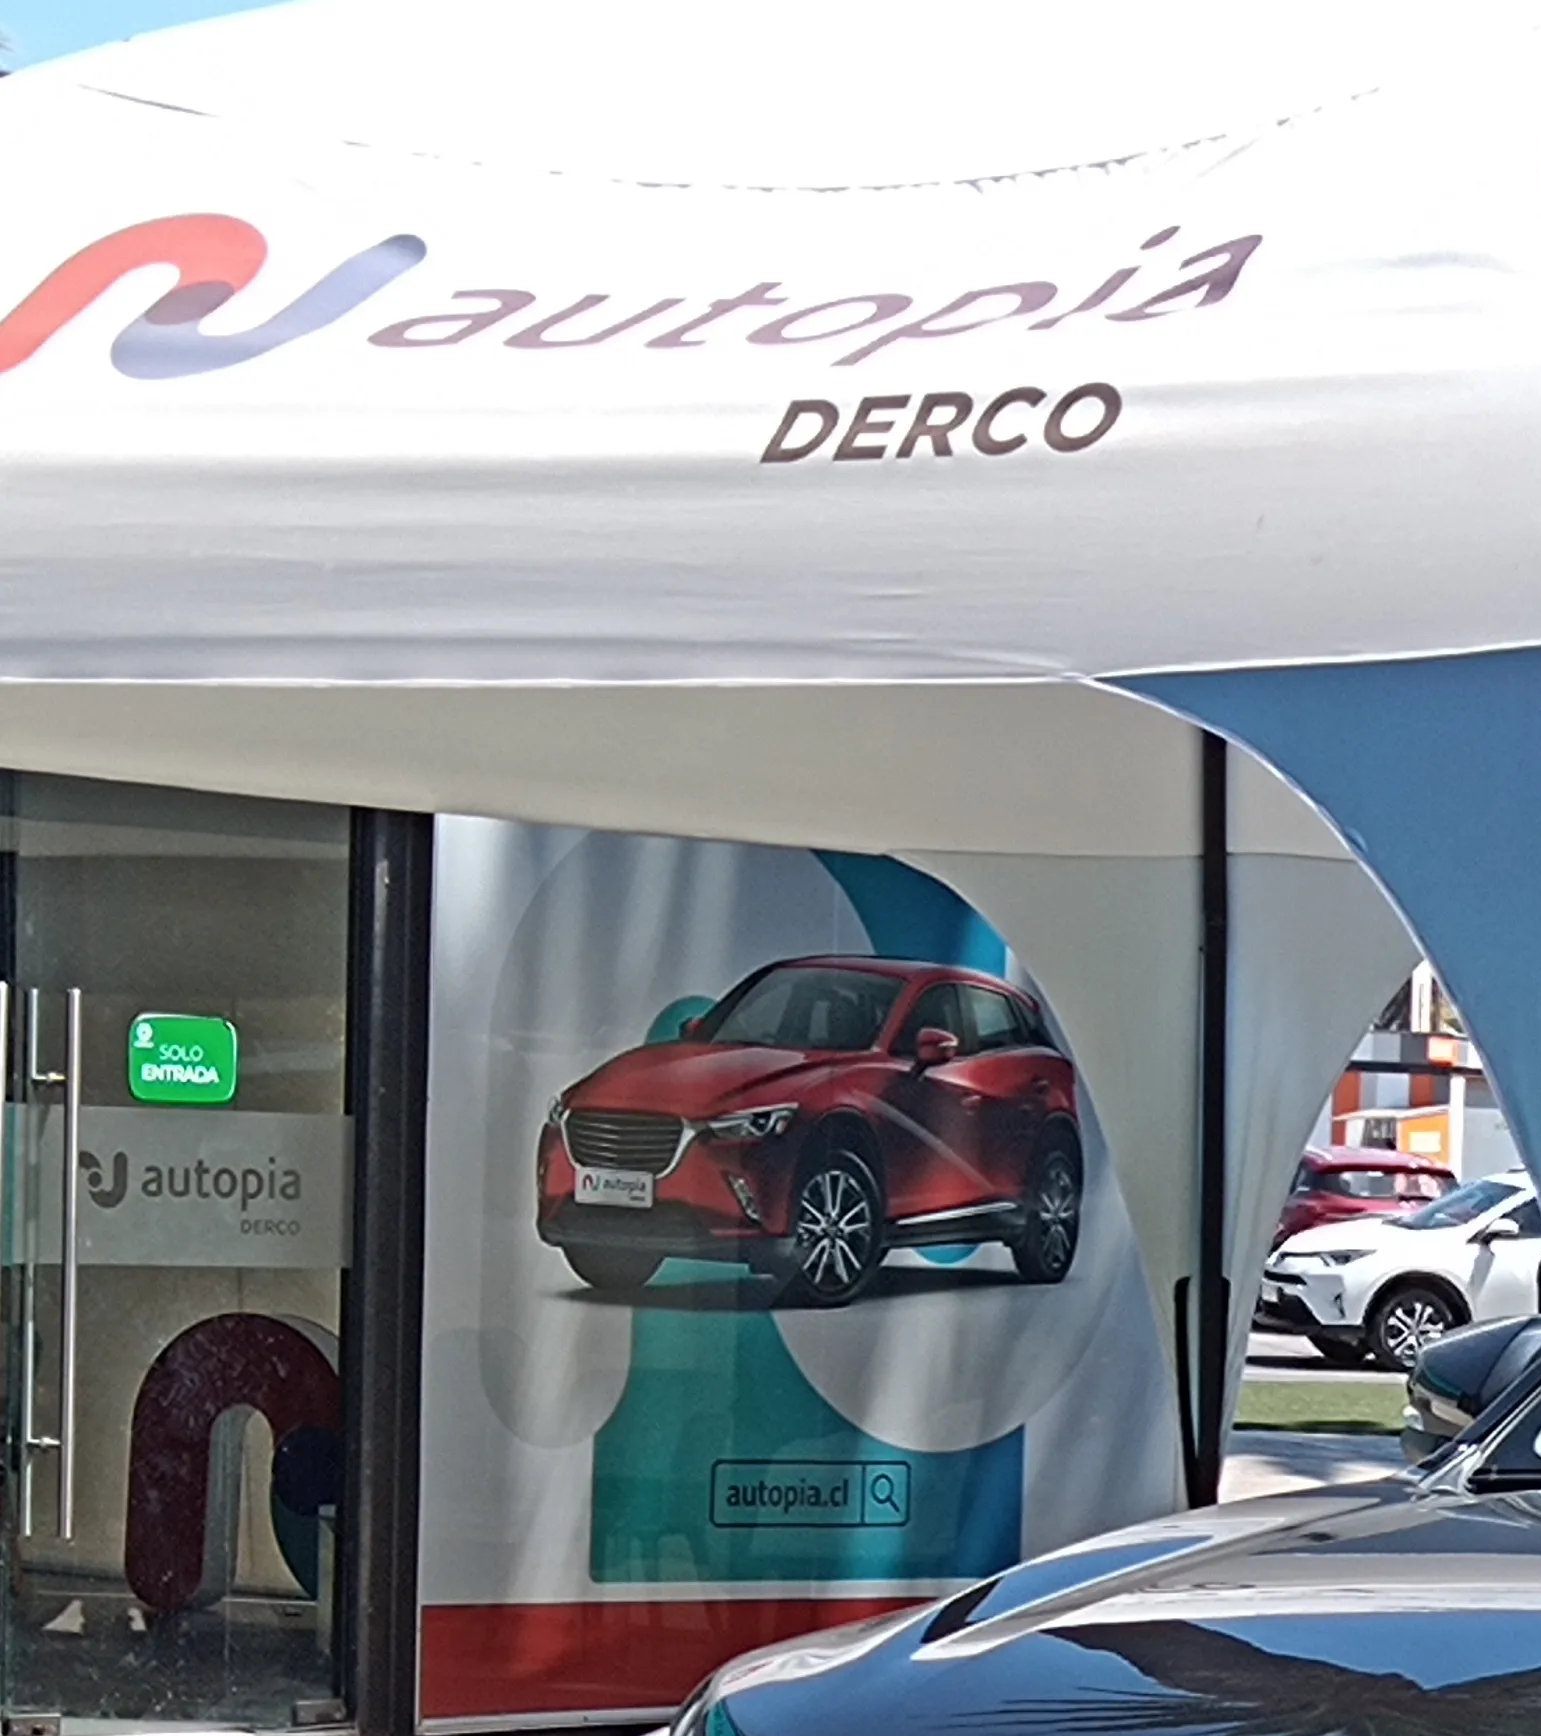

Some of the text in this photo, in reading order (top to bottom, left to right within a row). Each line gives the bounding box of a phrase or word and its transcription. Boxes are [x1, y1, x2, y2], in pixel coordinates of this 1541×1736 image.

[367, 225, 1264, 368] autopia
[760, 382, 1123, 465] DERCO
[159, 1045, 204, 1062] SOLO
[141, 1063, 220, 1084] ENTRADA
[141, 1156, 301, 1212] autopia
[240, 1219, 301, 1236] DERCO
[726, 1478, 849, 1514] autopia.cl
